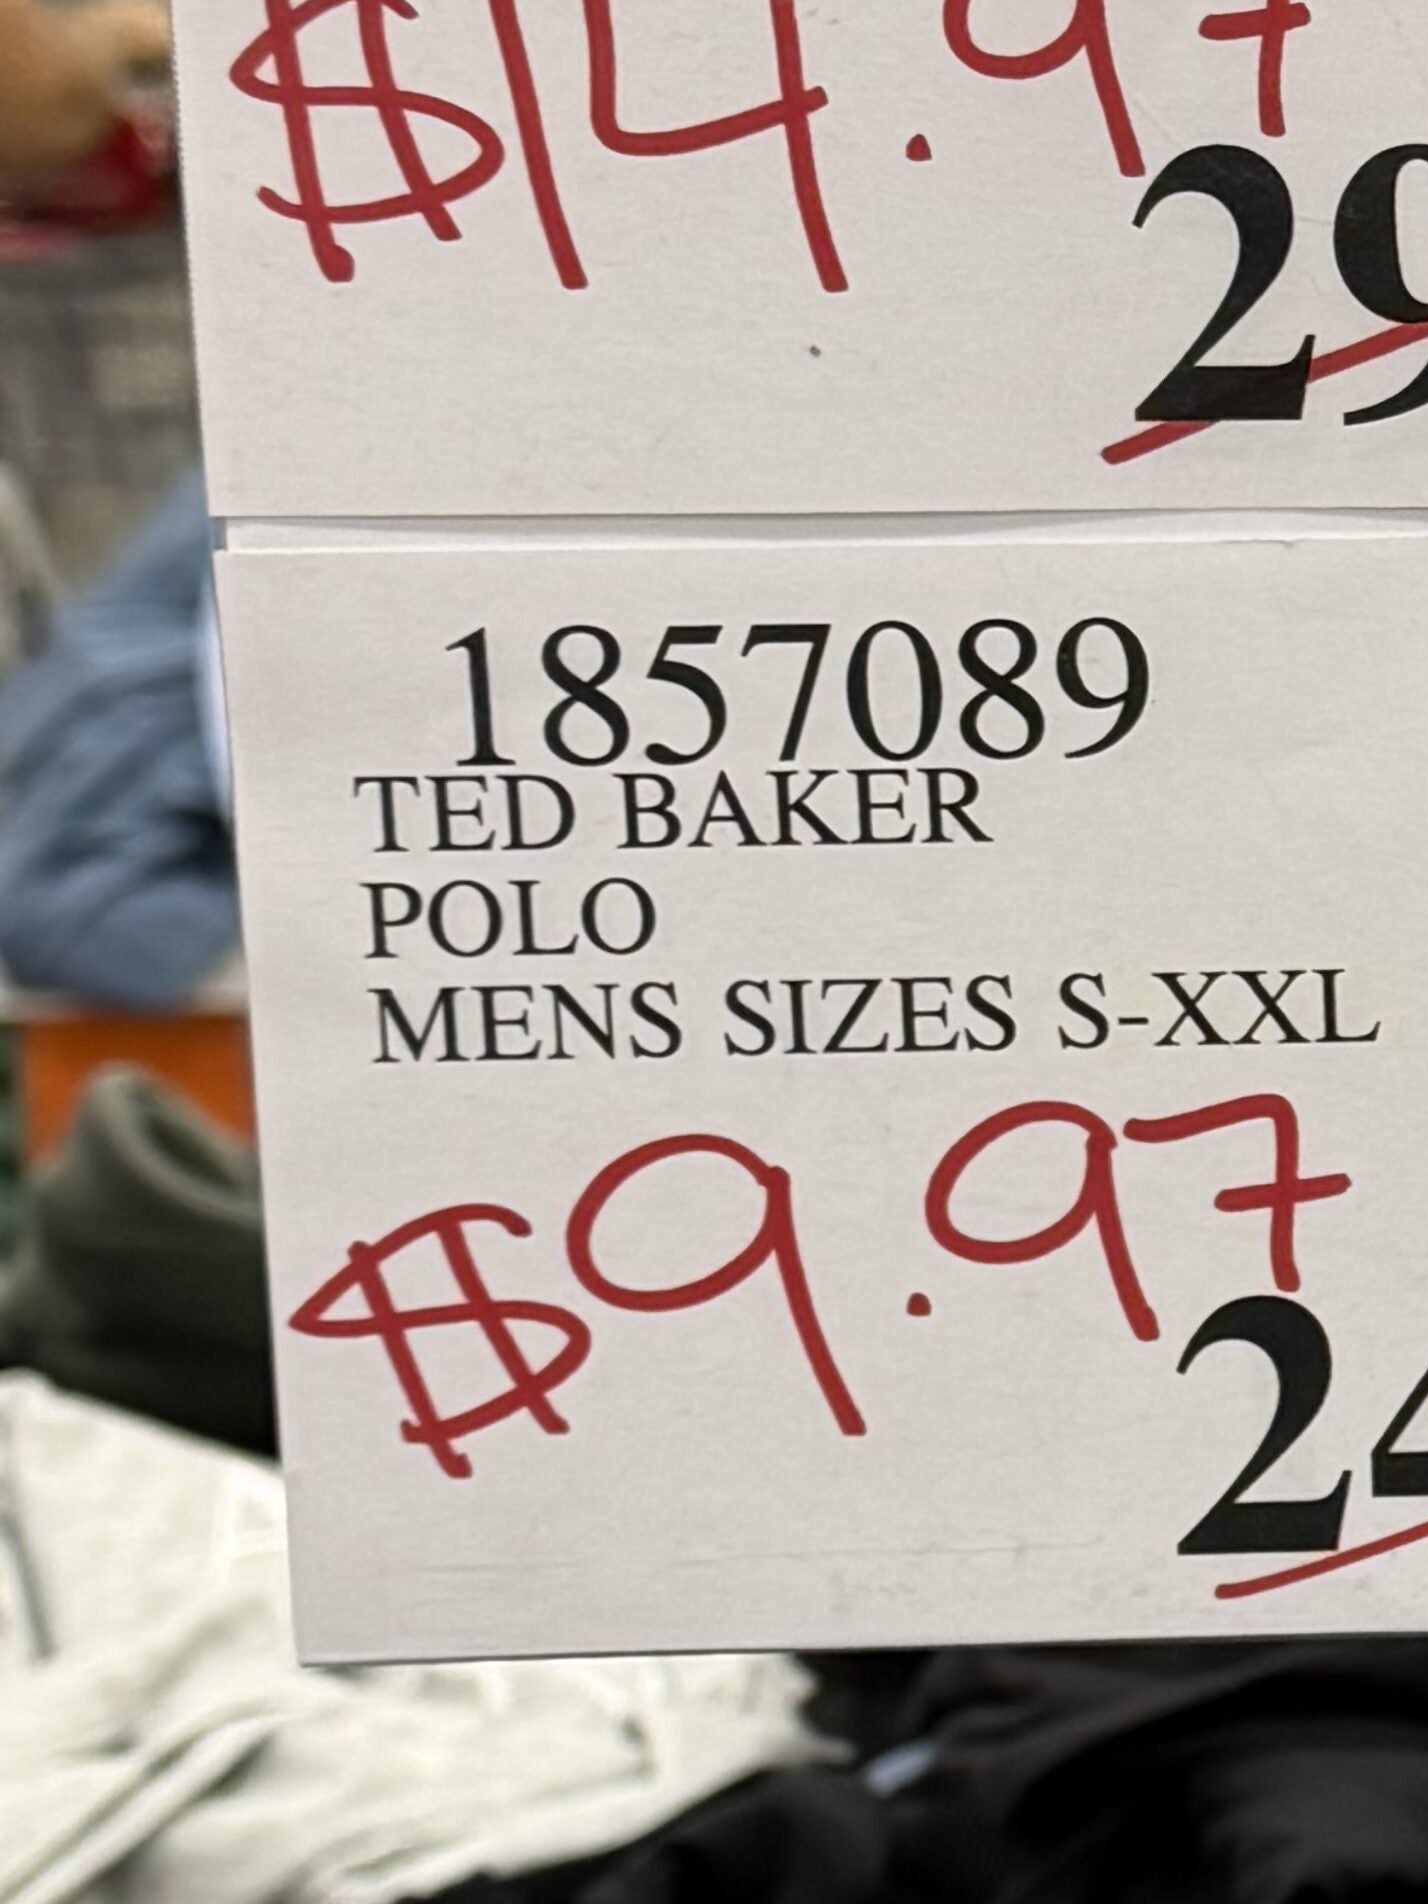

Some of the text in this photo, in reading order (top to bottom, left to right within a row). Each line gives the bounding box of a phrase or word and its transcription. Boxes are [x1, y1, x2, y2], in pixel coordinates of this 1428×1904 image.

[445, 616, 1150, 768] 1857089
[353, 766, 995, 854] TED BAKER
[360, 876, 657, 960] POLO
[367, 967, 1382, 1064] MENS SIZES S-XXL
[289, 1093, 1351, 1479] $9.97
